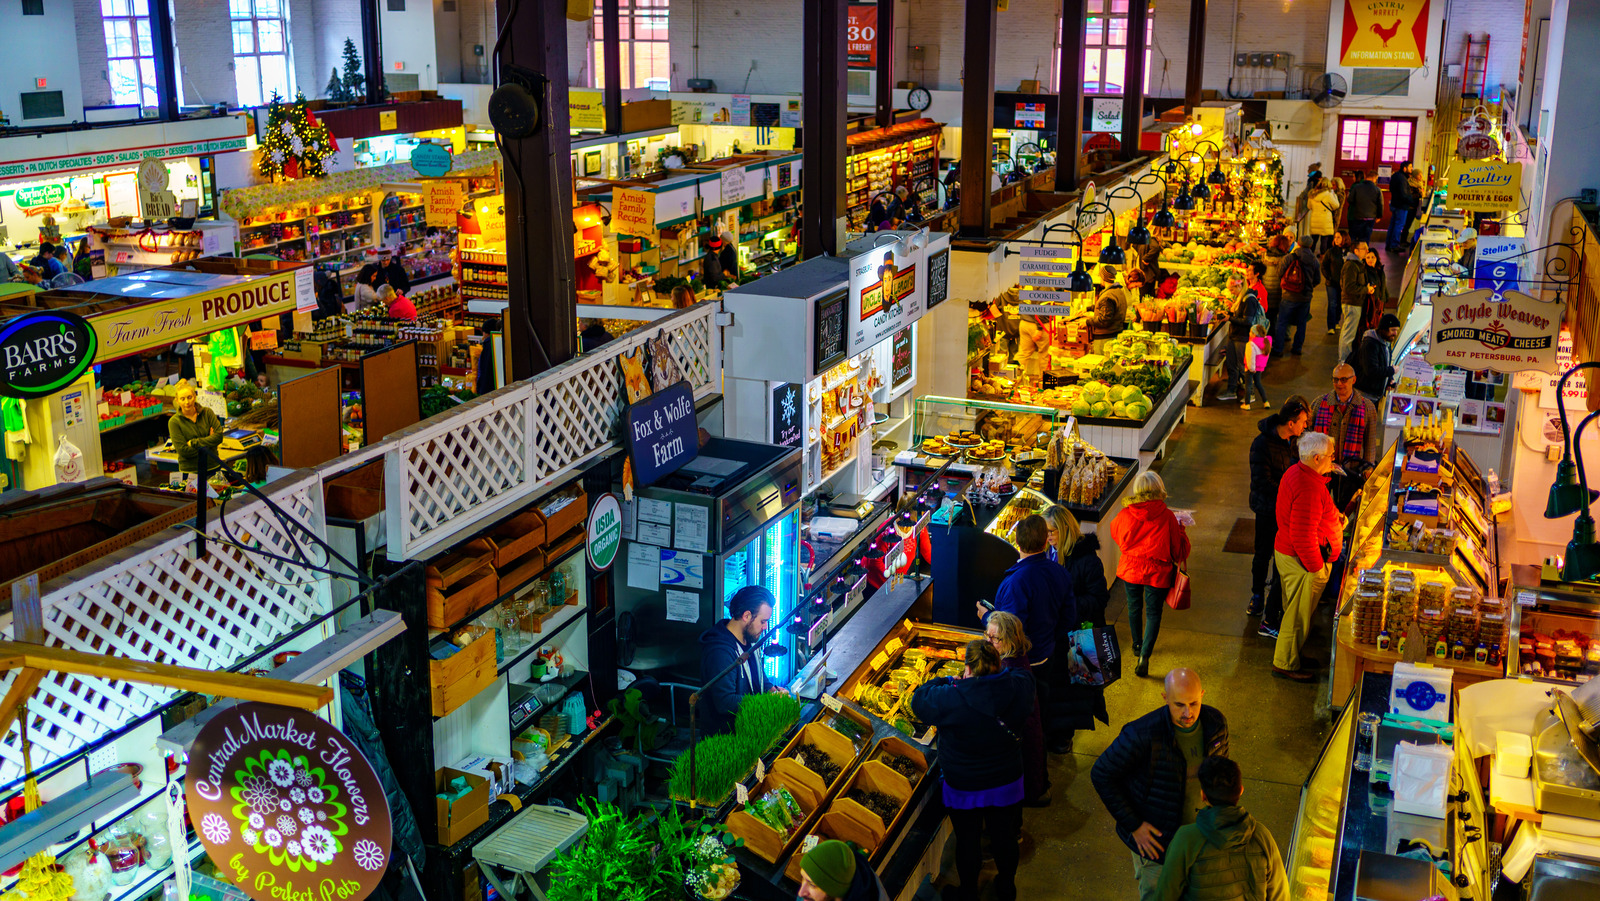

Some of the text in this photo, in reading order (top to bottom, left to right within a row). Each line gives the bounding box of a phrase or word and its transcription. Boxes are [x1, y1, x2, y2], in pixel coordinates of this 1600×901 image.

[1368, 2, 1405, 10] CENTRAL
[1350, 51, 1393, 59] INFORMATION
[1097, 111, 1120, 120] Salad
[30, 162, 36, 172] PA
[38, 160, 58, 170] DUTCH
[58, 157, 92, 169] SPECIALTIES
[96, 154, 115, 164] SOUPS
[119, 152, 140, 162] SALADS
[143, 148, 165, 159] ENTREES
[169, 146, 194, 156] DESSERTS
[220, 139, 246, 150] SPECIALTIES
[1469, 164, 1503, 173] SHENK'S
[1457, 172, 1512, 186] Poultry
[431, 196, 456, 205] Family
[619, 201, 646, 215] Family
[620, 193, 646, 204] Amish
[146, 203, 170, 216] BREAD
[430, 205, 457, 216] Recipes
[617, 211, 647, 224] Recipes
[1482, 243, 1516, 255] Stella's
[202, 281, 290, 320] PRODUCE
[863, 274, 914, 310] UNCLE LEROY'S
[874, 306, 904, 328] CANDY KITCHEN
[1441, 302, 1549, 330] S. Clyde Weaver
[107, 308, 192, 346] Farm Fresh
[1442, 329, 1546, 348] SMOKED MEATS CHEESE
[633, 395, 692, 442] Fox & Wolfe
[652, 436, 684, 468] Farm
[595, 508, 615, 535] USDA
[594, 528, 618, 556] ORGANIC
[195, 711, 370, 825] Central Market Flowers
[229, 852, 361, 901] by Perfect Pots
